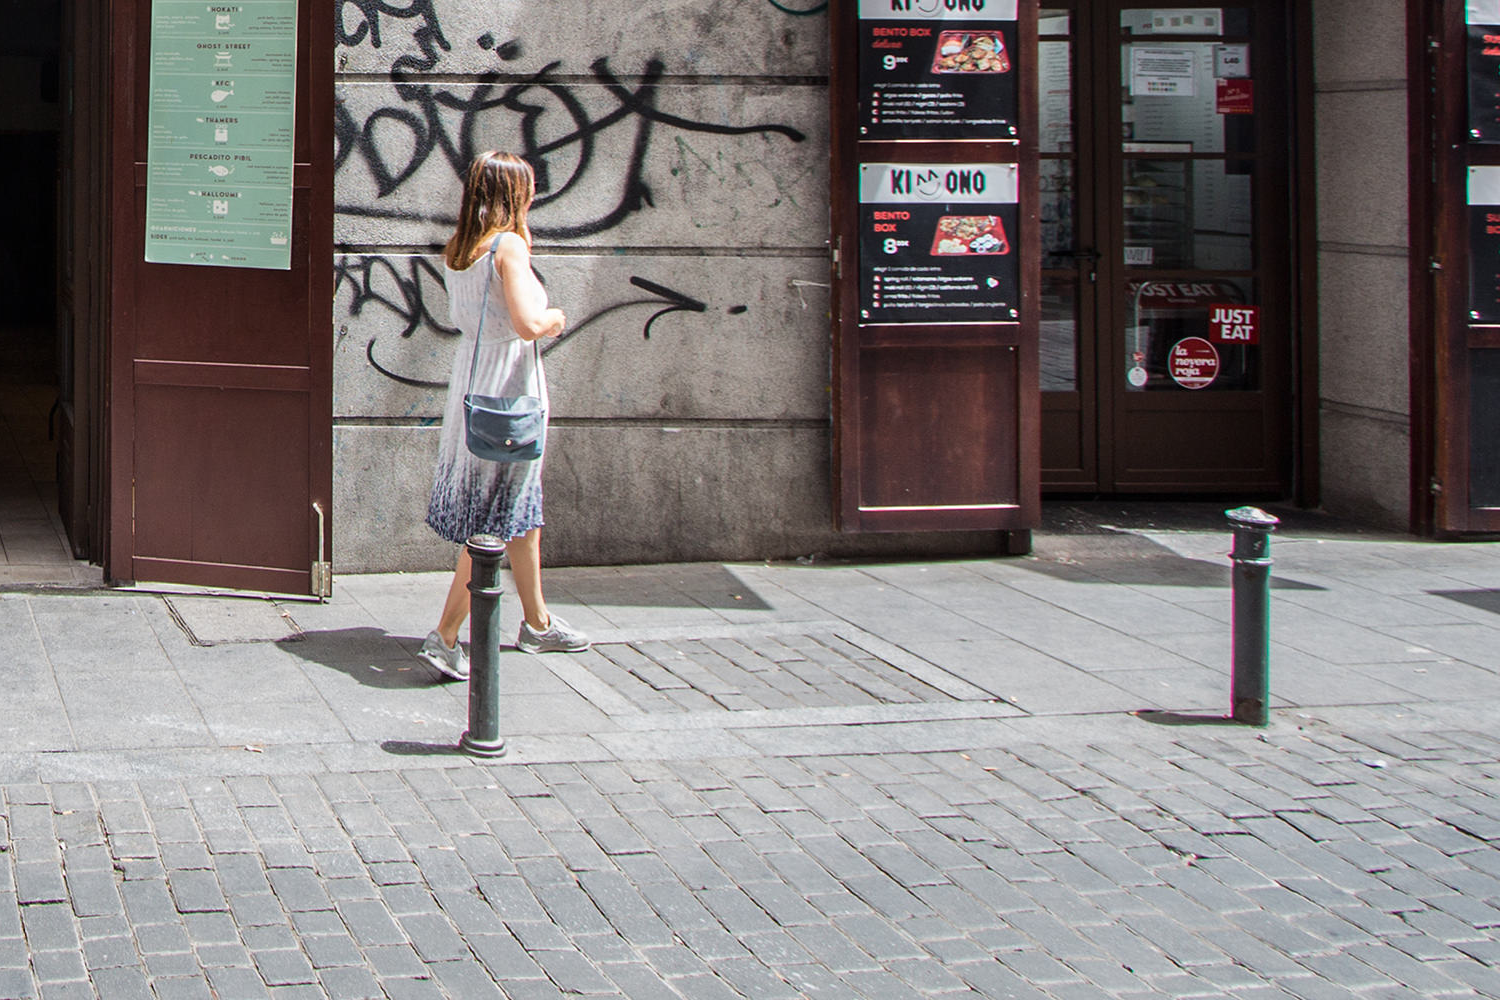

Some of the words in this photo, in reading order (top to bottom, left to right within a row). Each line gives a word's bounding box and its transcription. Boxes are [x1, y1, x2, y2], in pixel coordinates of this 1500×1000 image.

[872, 28, 908, 37] BENTO
[909, 28, 932, 37] BOX
[189, 153, 231, 161] PESCADITO
[201, 190, 239, 198] HALLOUMI
[873, 211, 911, 221] BENTO
[874, 223, 897, 232] BOX
[1211, 308, 1254, 324] JUST
[1221, 325, 1254, 340] EAT
[1175, 345, 1188, 356] la
[1175, 367, 1201, 377] roja
